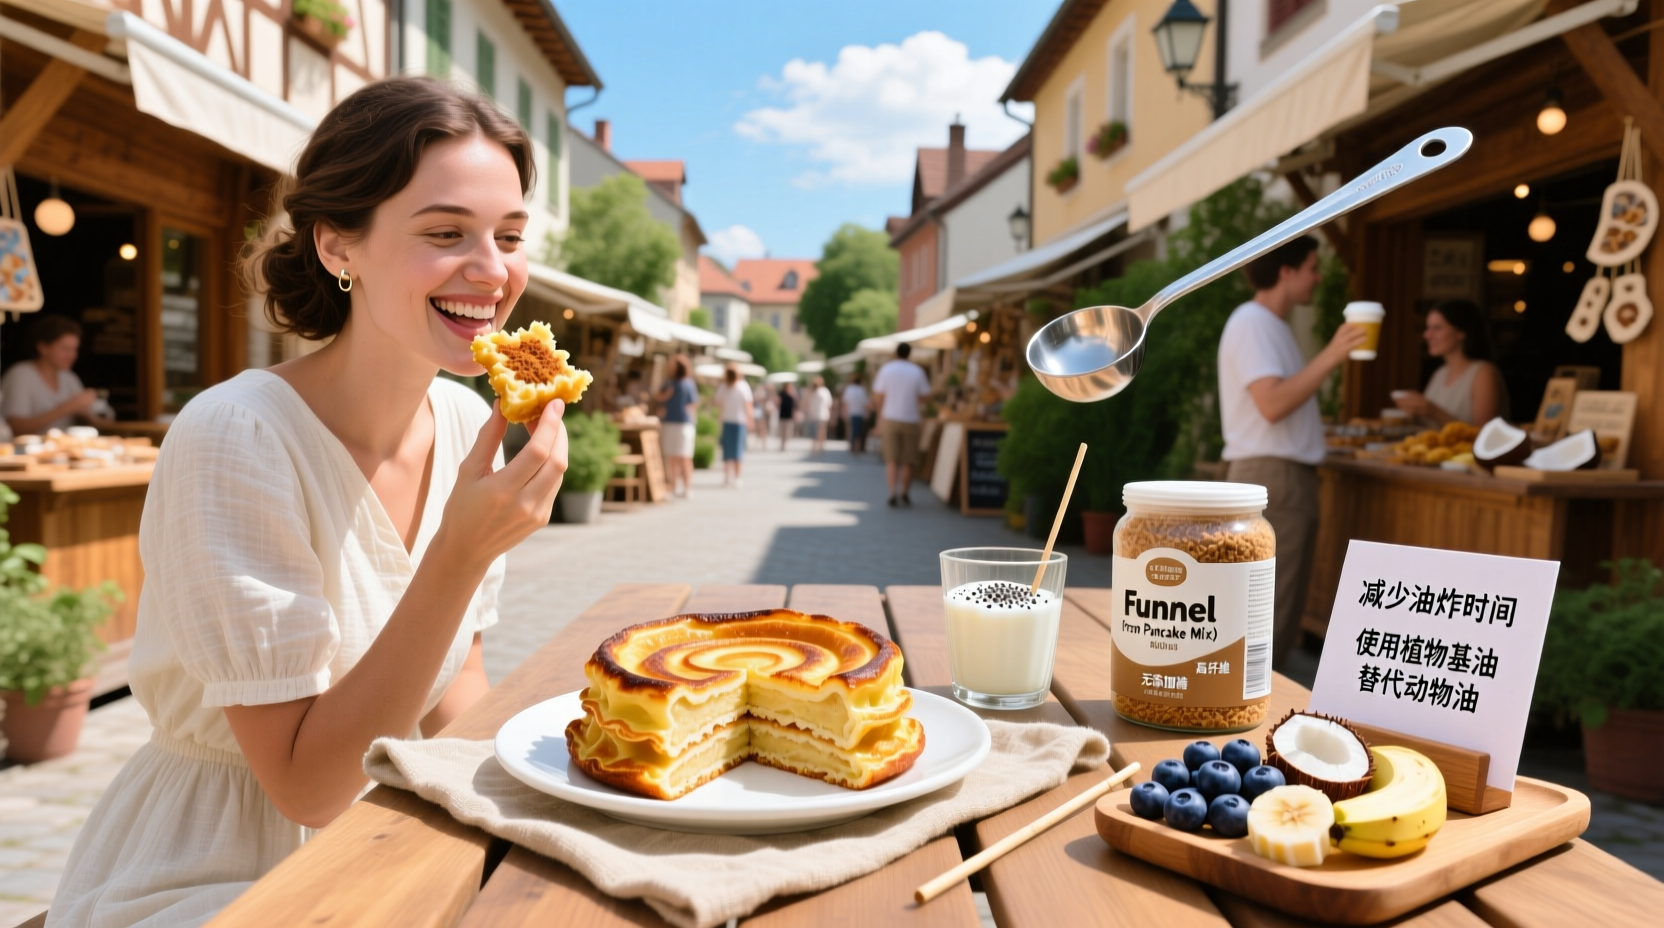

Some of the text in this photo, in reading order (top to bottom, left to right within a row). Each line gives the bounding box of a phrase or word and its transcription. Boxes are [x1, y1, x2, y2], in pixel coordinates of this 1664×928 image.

[1124, 589, 1217, 623] Funnel
[1358, 578, 1518, 628] 减少油炸时间
[1190, 627, 1218, 642] Mix)
[1356, 627, 1499, 679] 使用植物基油
[1358, 662, 1479, 713] 替代动物油
